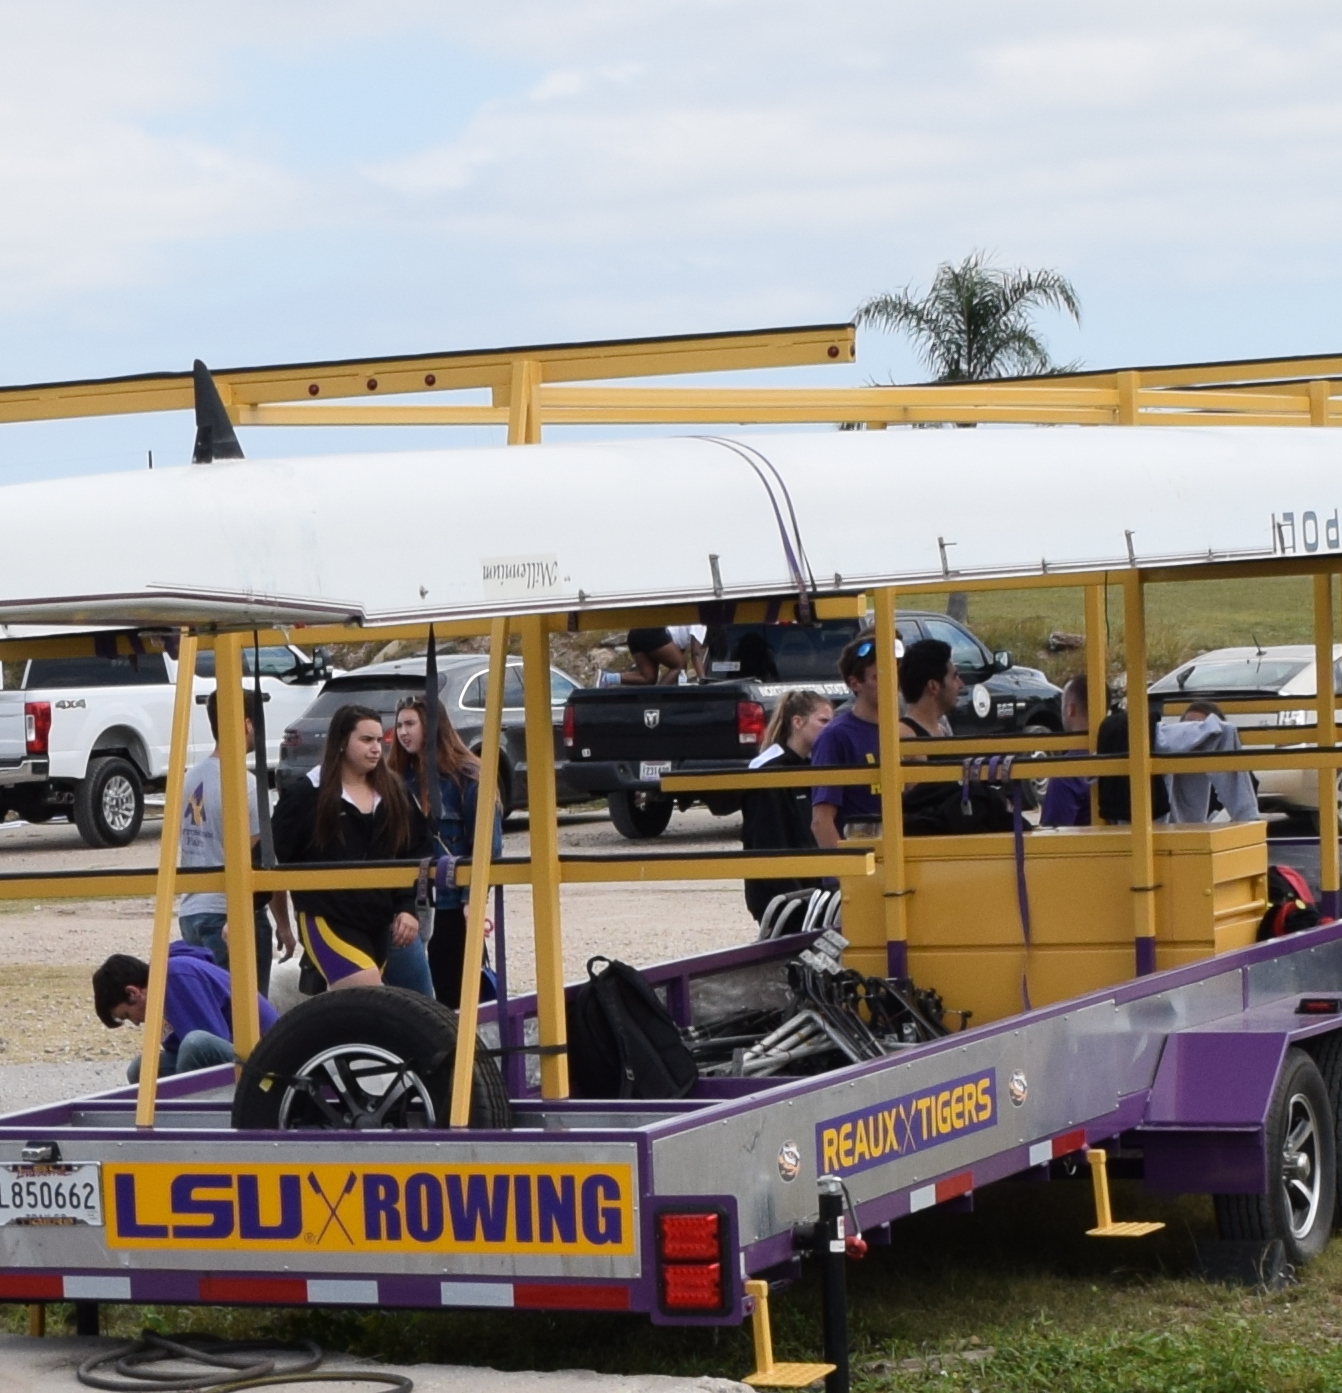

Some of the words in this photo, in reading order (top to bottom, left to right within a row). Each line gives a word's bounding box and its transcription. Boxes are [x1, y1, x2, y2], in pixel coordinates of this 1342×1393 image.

[482, 560, 558, 590] Millennium
[822, 1107, 899, 1174] REAUX
[917, 1077, 992, 1141] TIGERS
[0, 1181, 96, 1210] L850662
[114, 1172, 303, 1240] LSU
[363, 1172, 624, 1246] ROWING
